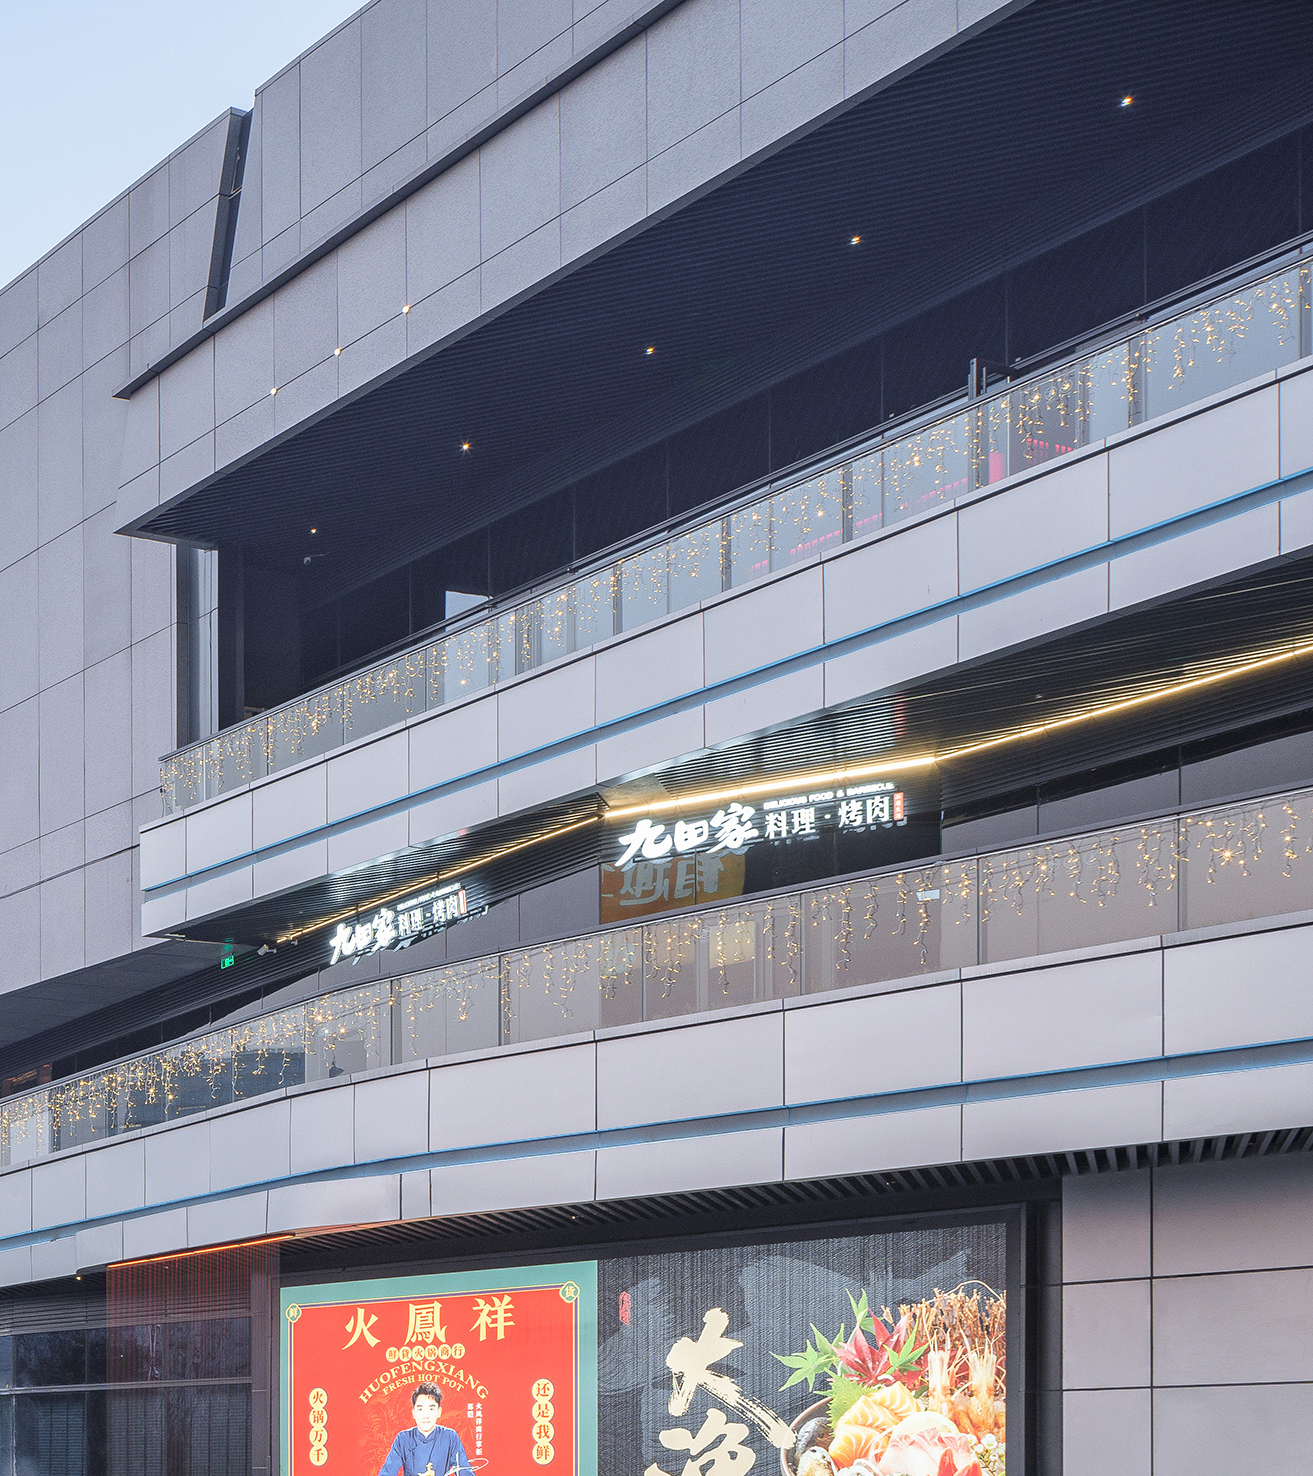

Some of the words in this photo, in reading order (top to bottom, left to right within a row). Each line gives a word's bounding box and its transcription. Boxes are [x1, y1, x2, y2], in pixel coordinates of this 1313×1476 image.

[808, 791, 834, 803] FOOD
[614, 802, 759, 867] 九田家
[342, 1294, 515, 1350] 火鳳祥
[359, 1360, 489, 1404] HUOFENGXIANG
[382, 1375, 416, 1396] FRESH
[417, 1373, 441, 1382] HOT
[442, 1376, 465, 1392] POT
[311, 1390, 325, 1464] 火锅万千
[534, 1381, 551, 1462] 还是我鲜
